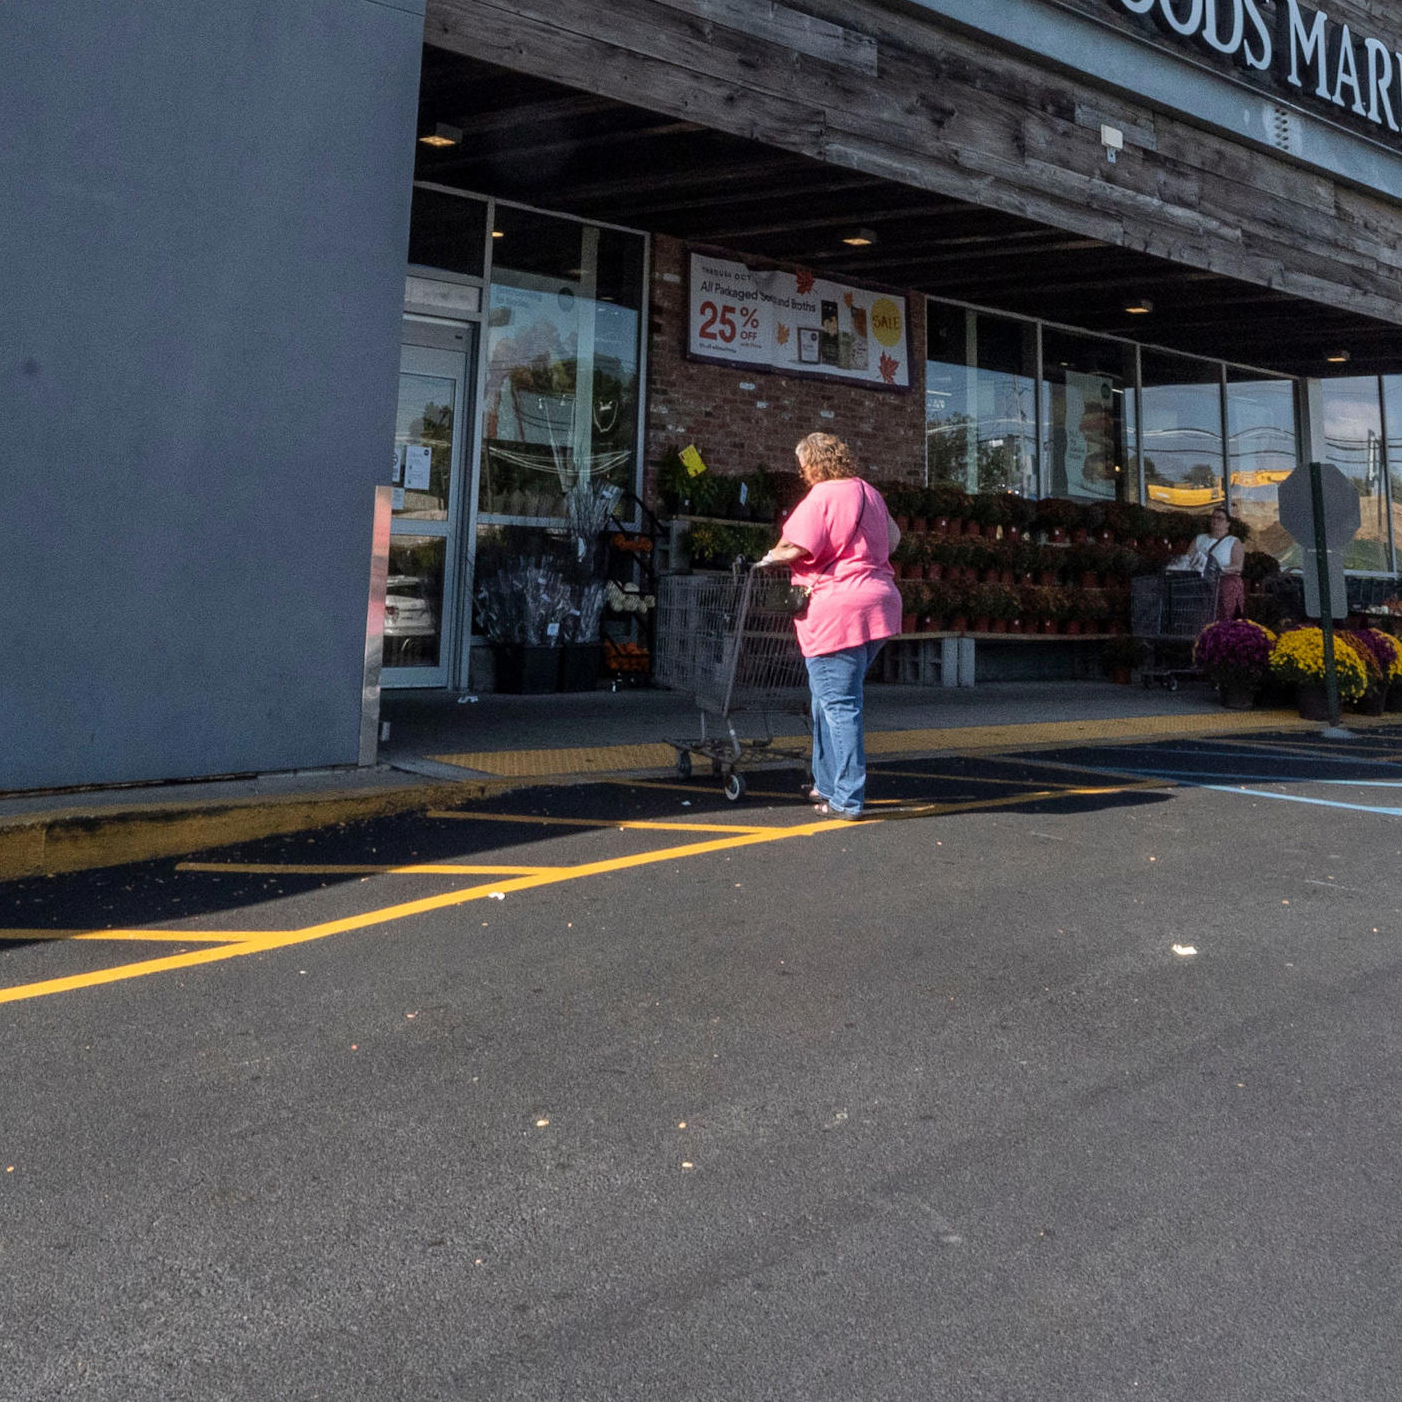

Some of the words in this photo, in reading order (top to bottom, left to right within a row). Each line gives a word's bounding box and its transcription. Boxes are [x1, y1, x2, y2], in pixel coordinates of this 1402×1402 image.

[700, 280, 713, 293] All
[714, 282, 758, 302] Packaged
[740, 330, 758, 341] OFF
